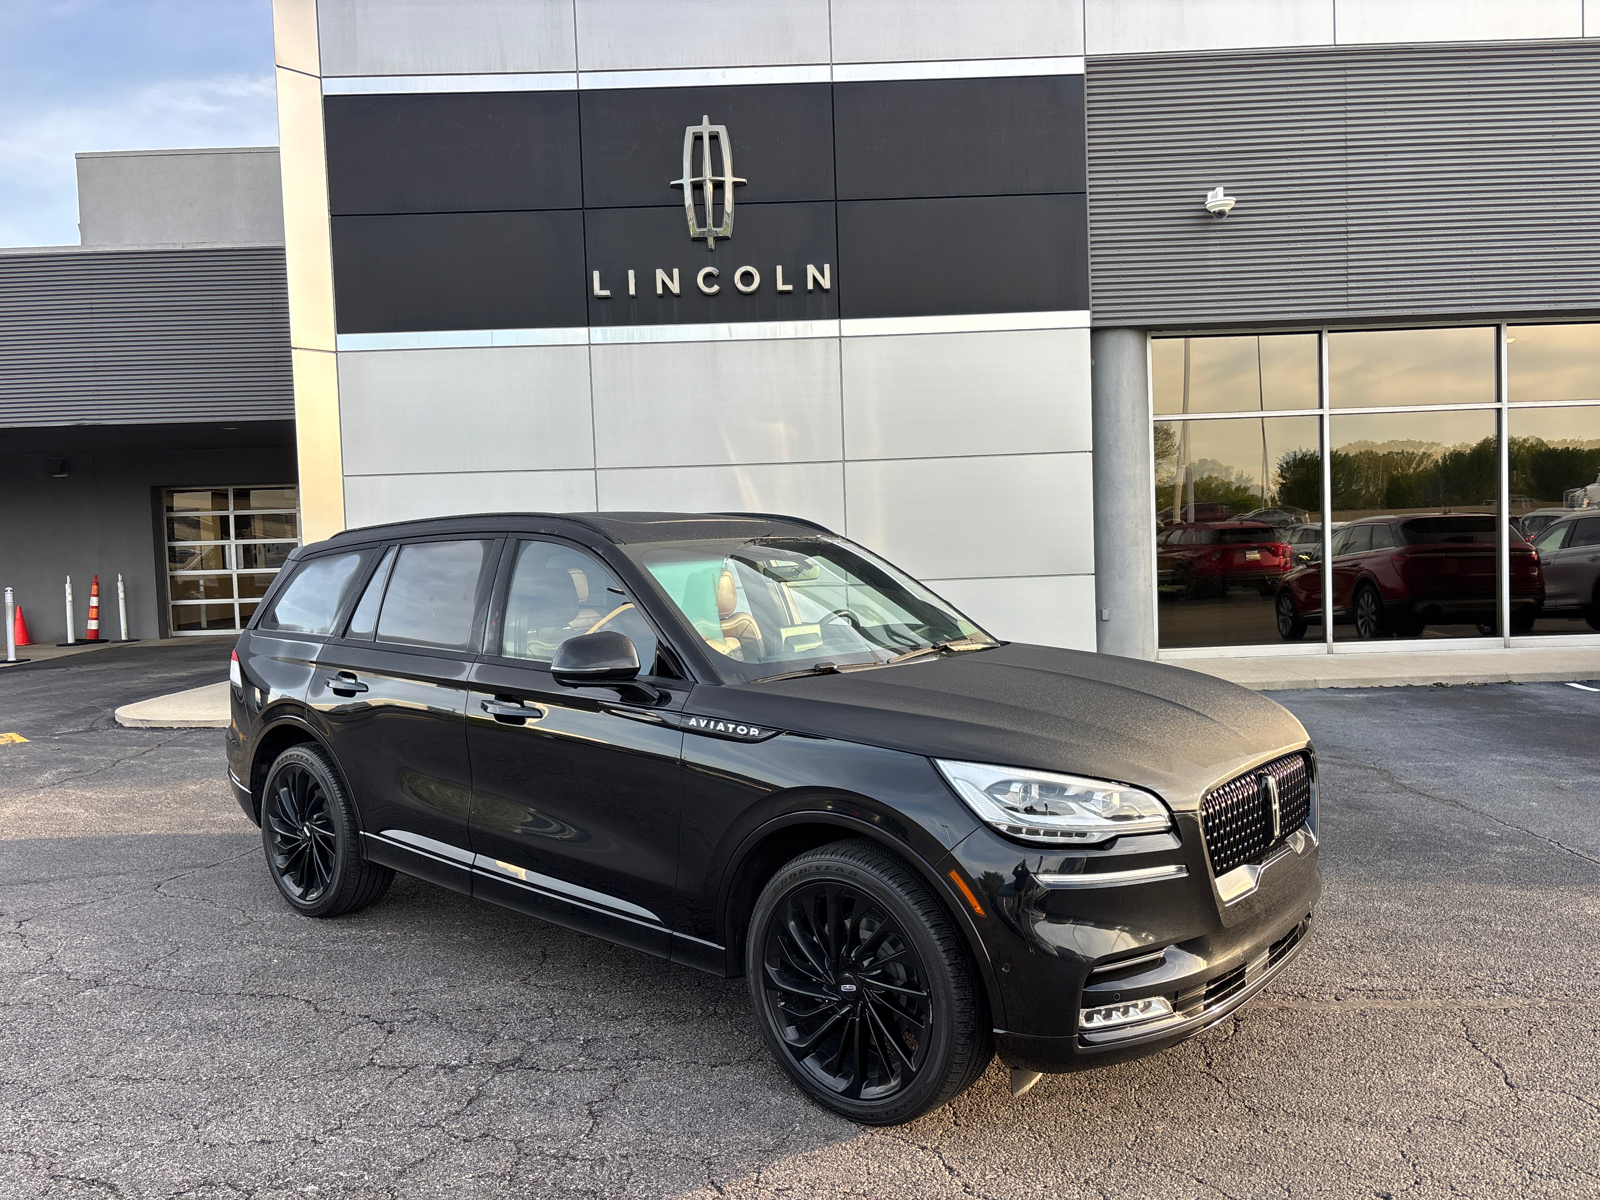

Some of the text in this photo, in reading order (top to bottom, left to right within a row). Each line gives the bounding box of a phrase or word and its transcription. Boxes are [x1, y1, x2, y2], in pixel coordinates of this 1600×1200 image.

[593, 263, 831, 298] LINCOLN
[689, 718, 759, 736] AVIATOR
[772, 865, 859, 894] GOODYEAR
